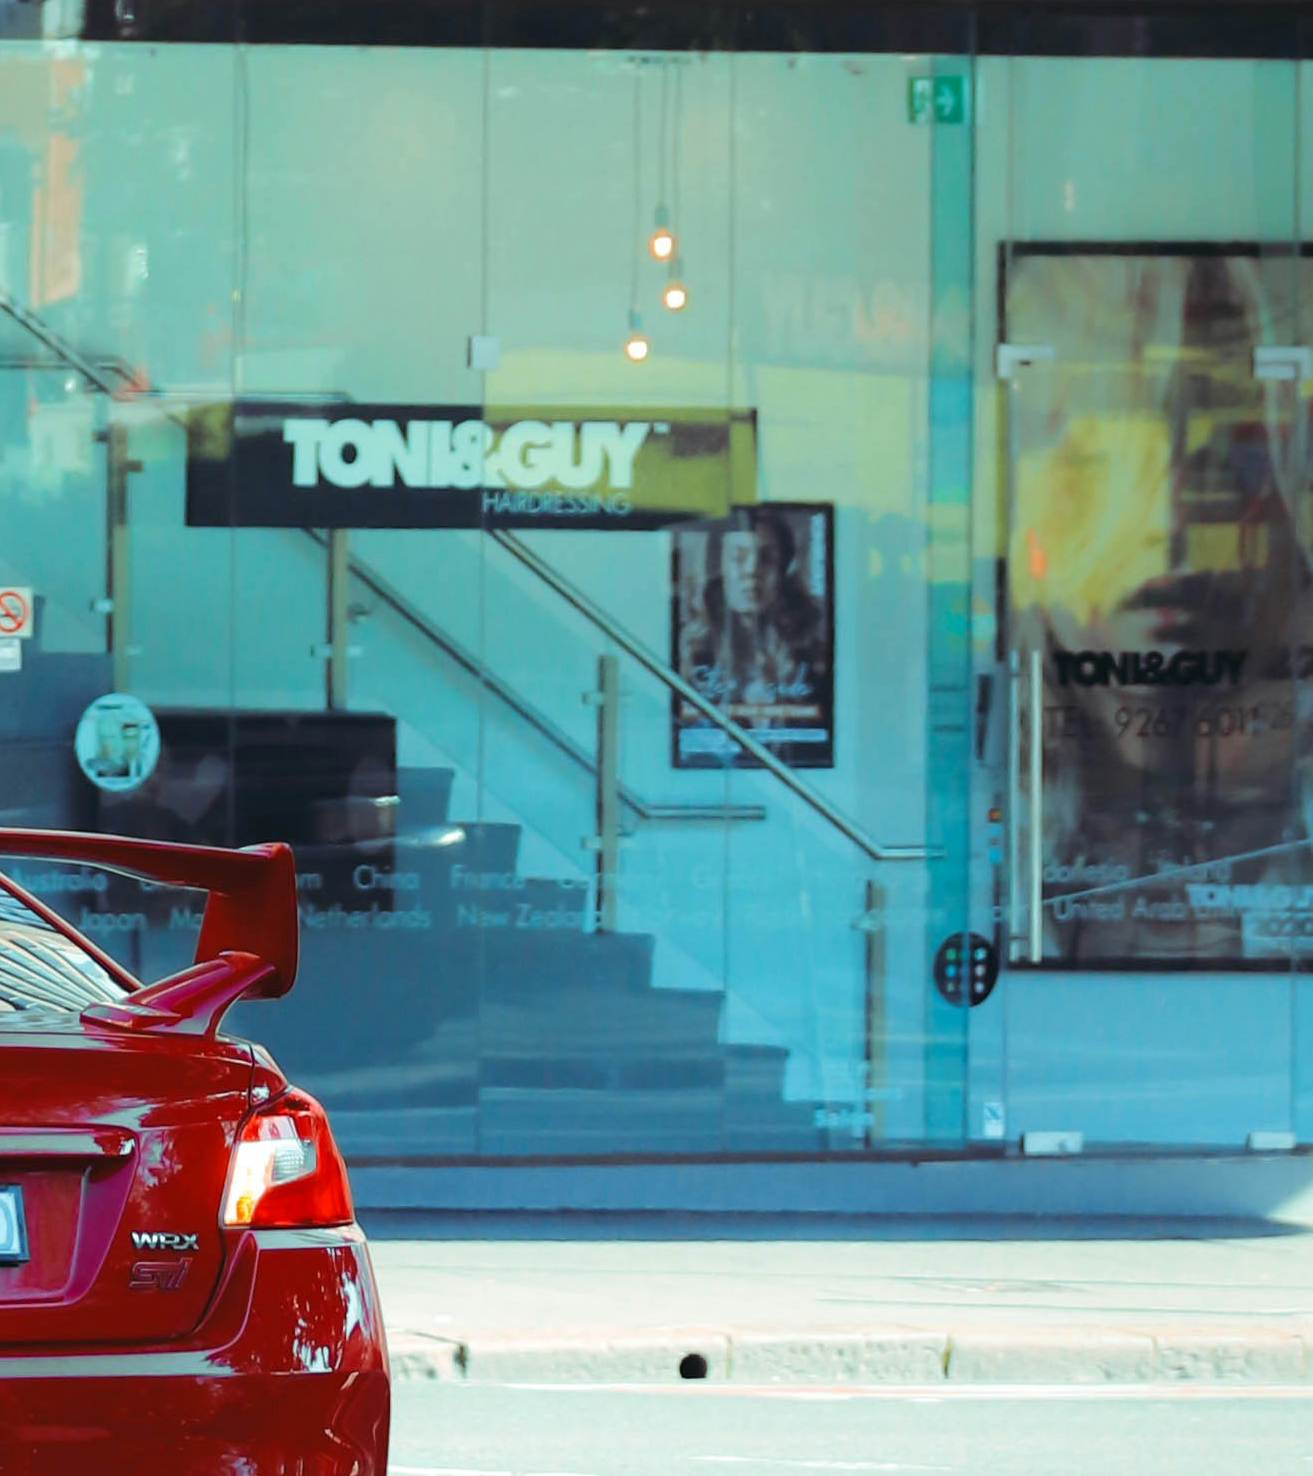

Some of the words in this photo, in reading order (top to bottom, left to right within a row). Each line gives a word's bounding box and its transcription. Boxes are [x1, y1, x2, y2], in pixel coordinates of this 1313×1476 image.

[282, 417, 649, 489] TONI&GUY
[482, 491, 631, 515] HAIRDRESSING
[1052, 649, 1248, 686] TONI&GUY
[1114, 705, 1188, 738] 926
[352, 863, 421, 891] China
[78, 907, 148, 937] Japan
[130, 1230, 200, 1251] WRX
